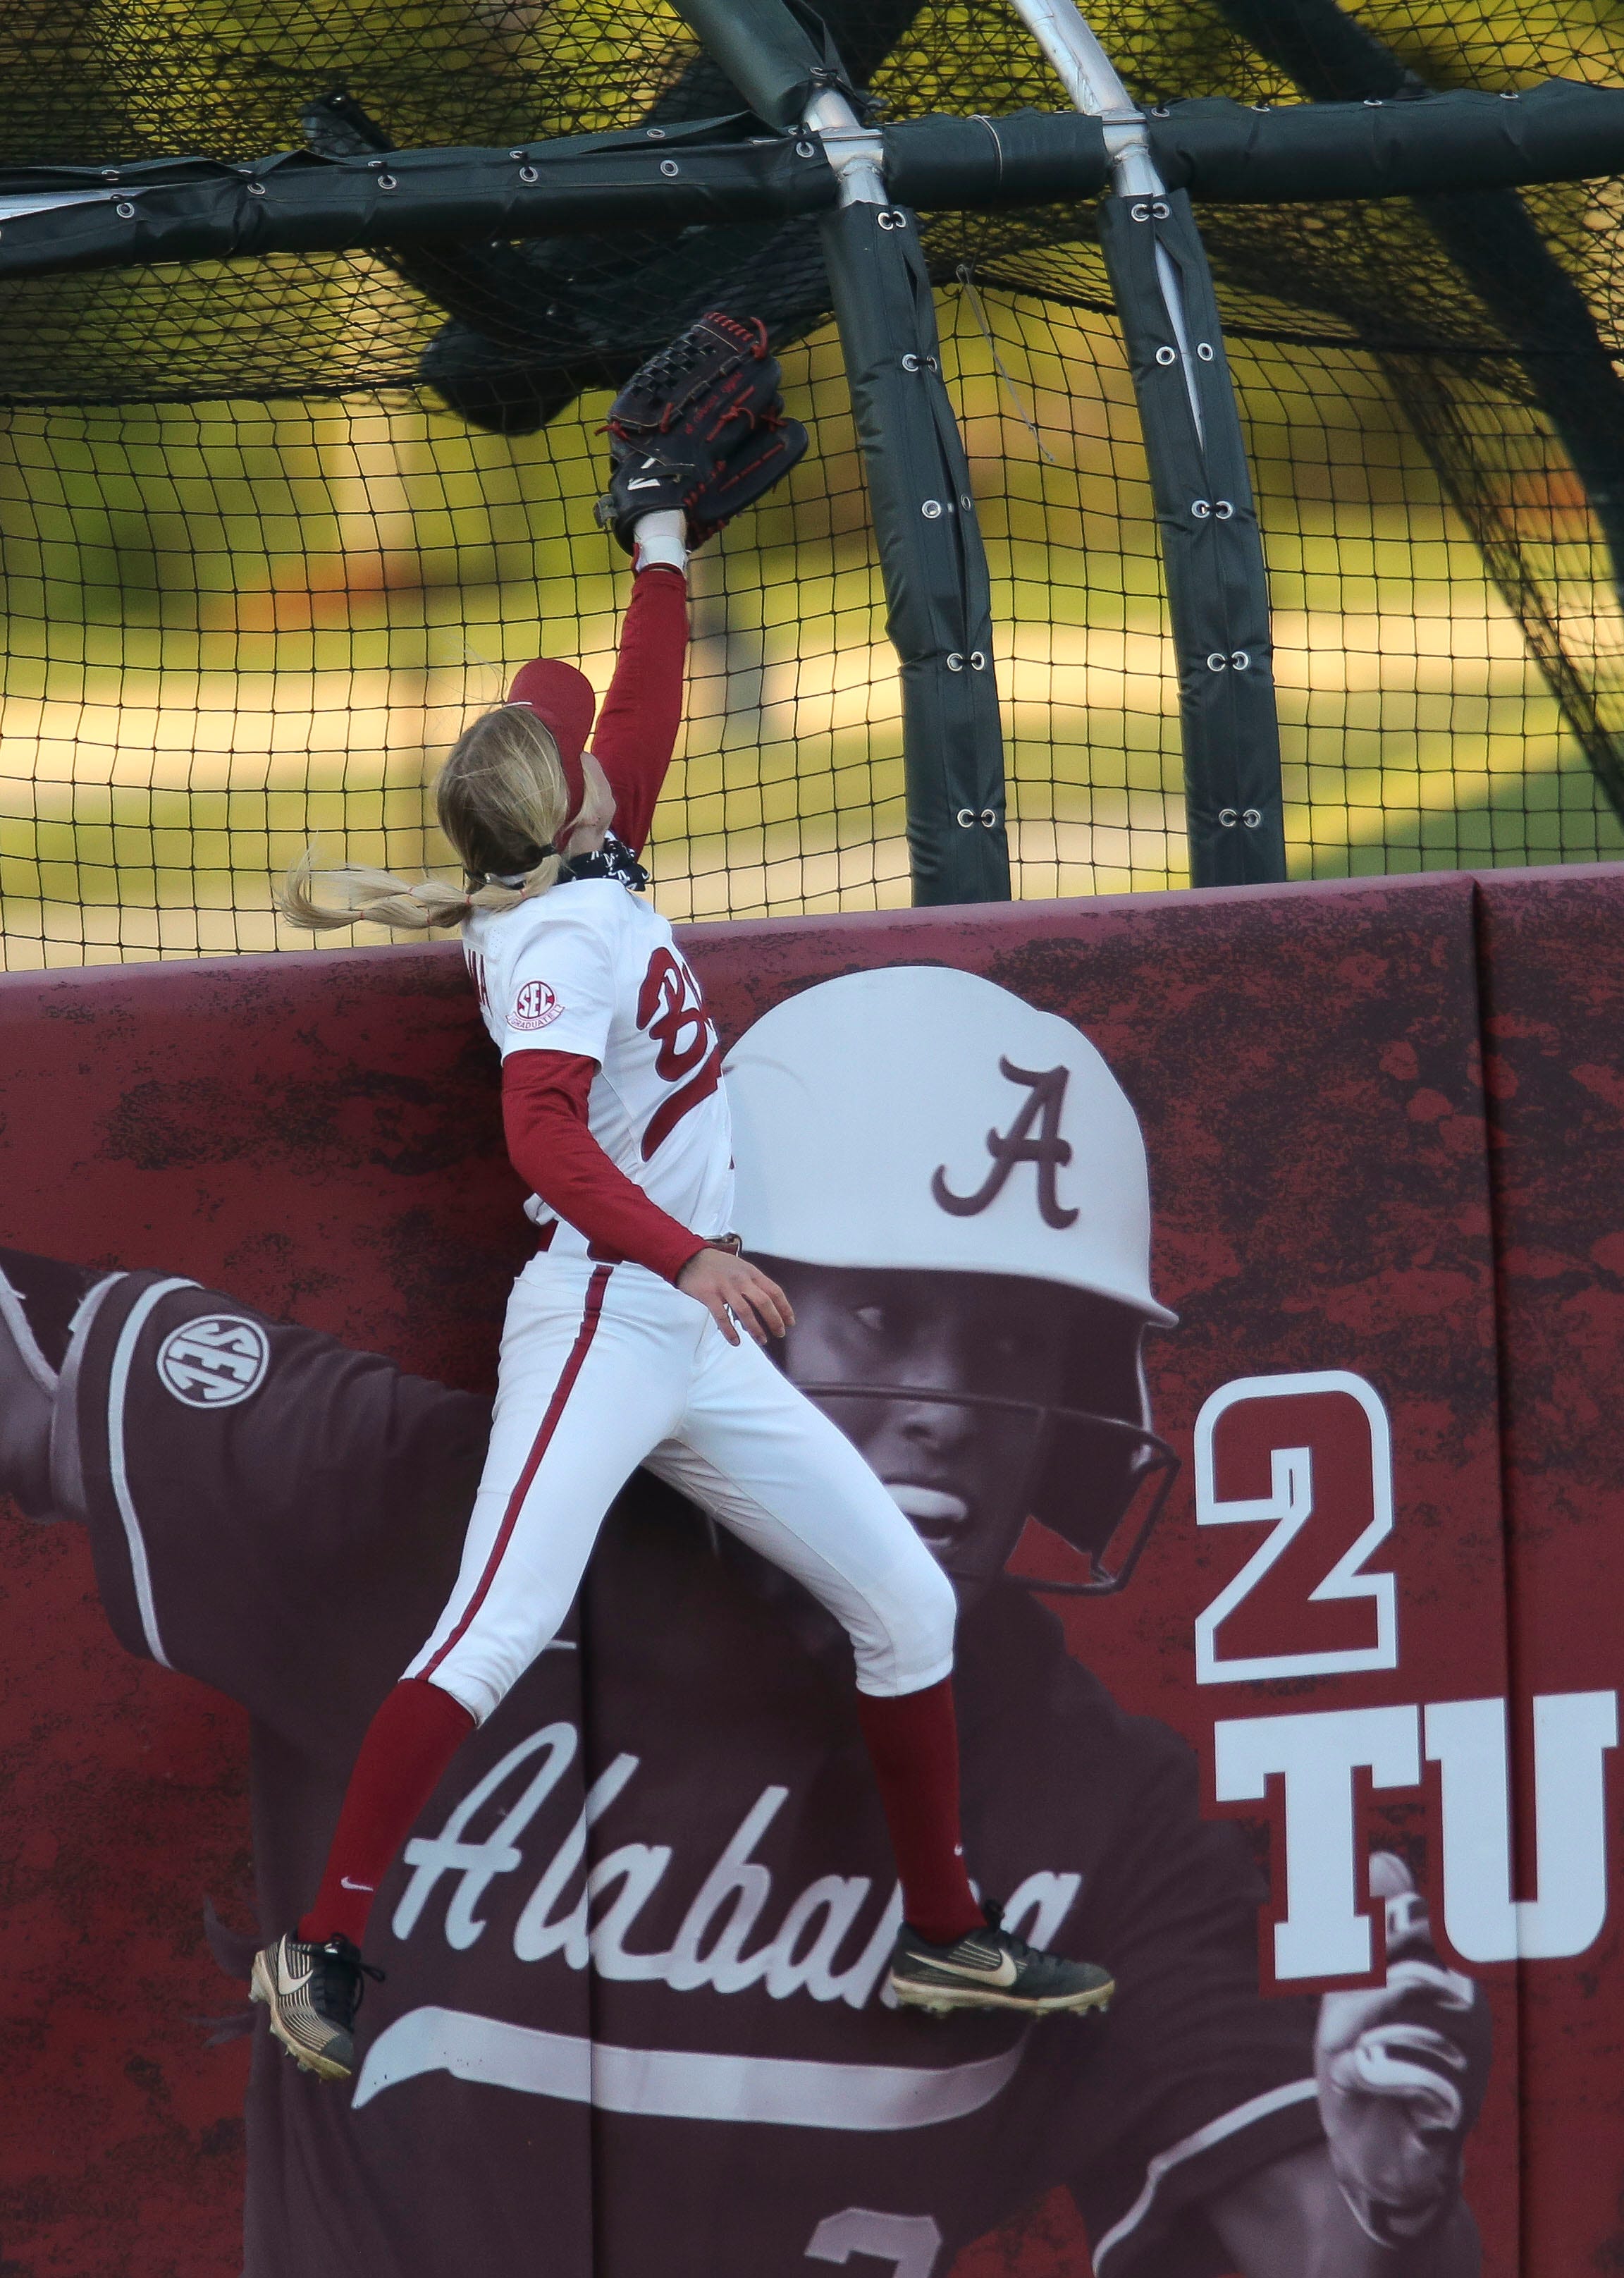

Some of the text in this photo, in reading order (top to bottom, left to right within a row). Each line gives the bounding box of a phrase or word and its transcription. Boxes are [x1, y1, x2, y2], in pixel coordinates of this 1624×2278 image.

[518, 981, 554, 1018] SEC
[931, 1055, 1079, 1229] A
[165, 1322, 261, 1400] SEC
[1194, 1370, 1397, 1684] 2
[1214, 1690, 1618, 1979] TU
